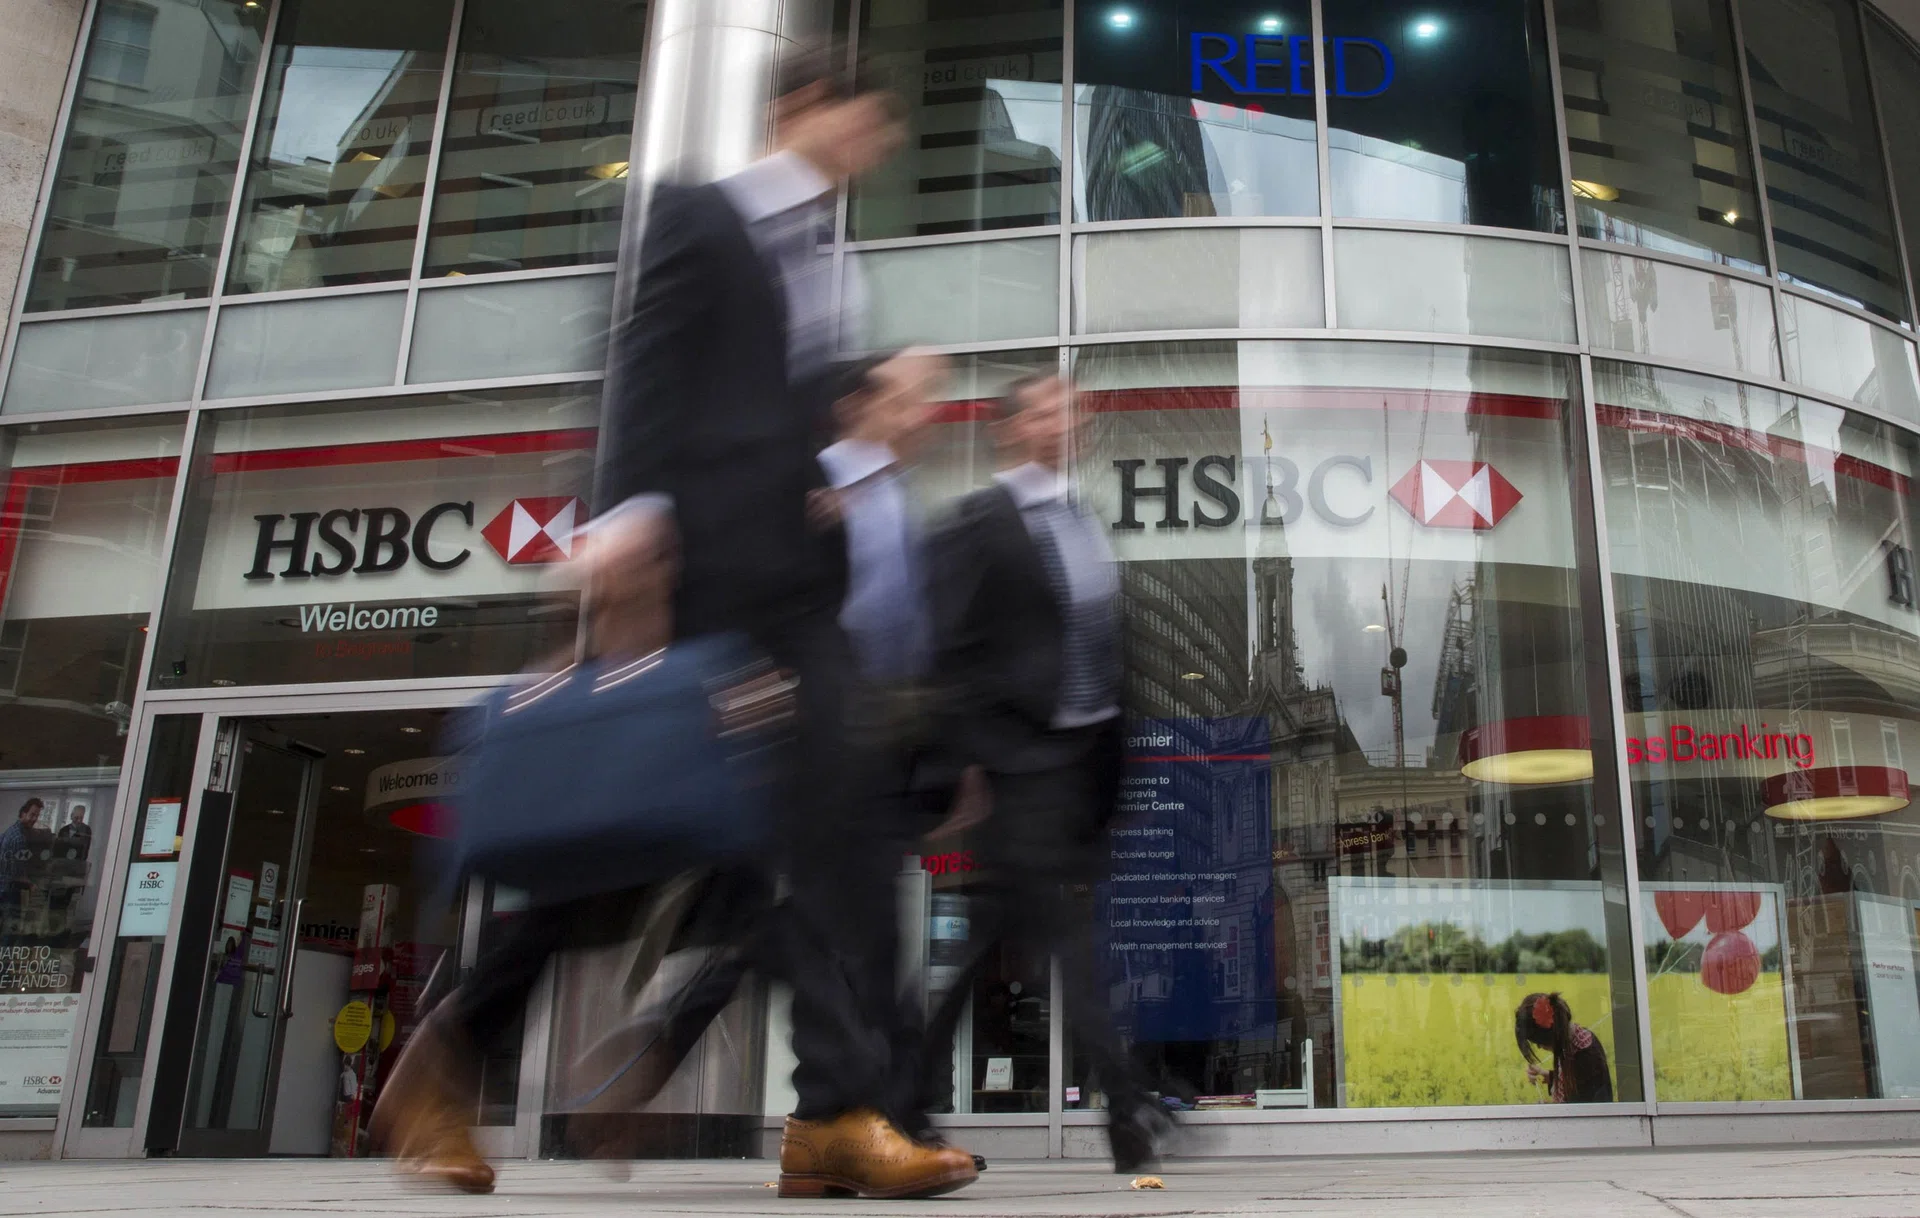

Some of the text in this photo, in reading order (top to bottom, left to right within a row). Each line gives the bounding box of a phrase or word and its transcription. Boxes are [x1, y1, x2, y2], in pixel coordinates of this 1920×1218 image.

[1190, 31, 1395, 97] REED
[1112, 454, 1376, 530] HSBC
[243, 501, 475, 580] HSBC
[299, 604, 438, 633] Welcome
[1122, 732, 1173, 748] remier
[380, 772, 439, 793] Welcome
[1119, 776, 1170, 785] elcome to
[1118, 788, 1157, 800] elgravia
[1116, 801, 1185, 812] remier Centre
[1110, 827, 1174, 838] Express banking
[1110, 850, 1175, 860] Exclusive lounge
[1110, 871, 1237, 882] Dedicated relationship managers
[139, 880, 164, 889] HSBC
[1110, 894, 1226, 905] International banking services
[1110, 917, 1220, 929] Local knowledge and advice
[33, 945, 51, 959] TO
[1110, 941, 1228, 952] Wealth management services
[5, 961, 16, 973] A
[19, 960, 60, 973] HOME
[24, 1076, 48, 1086] HSBC
